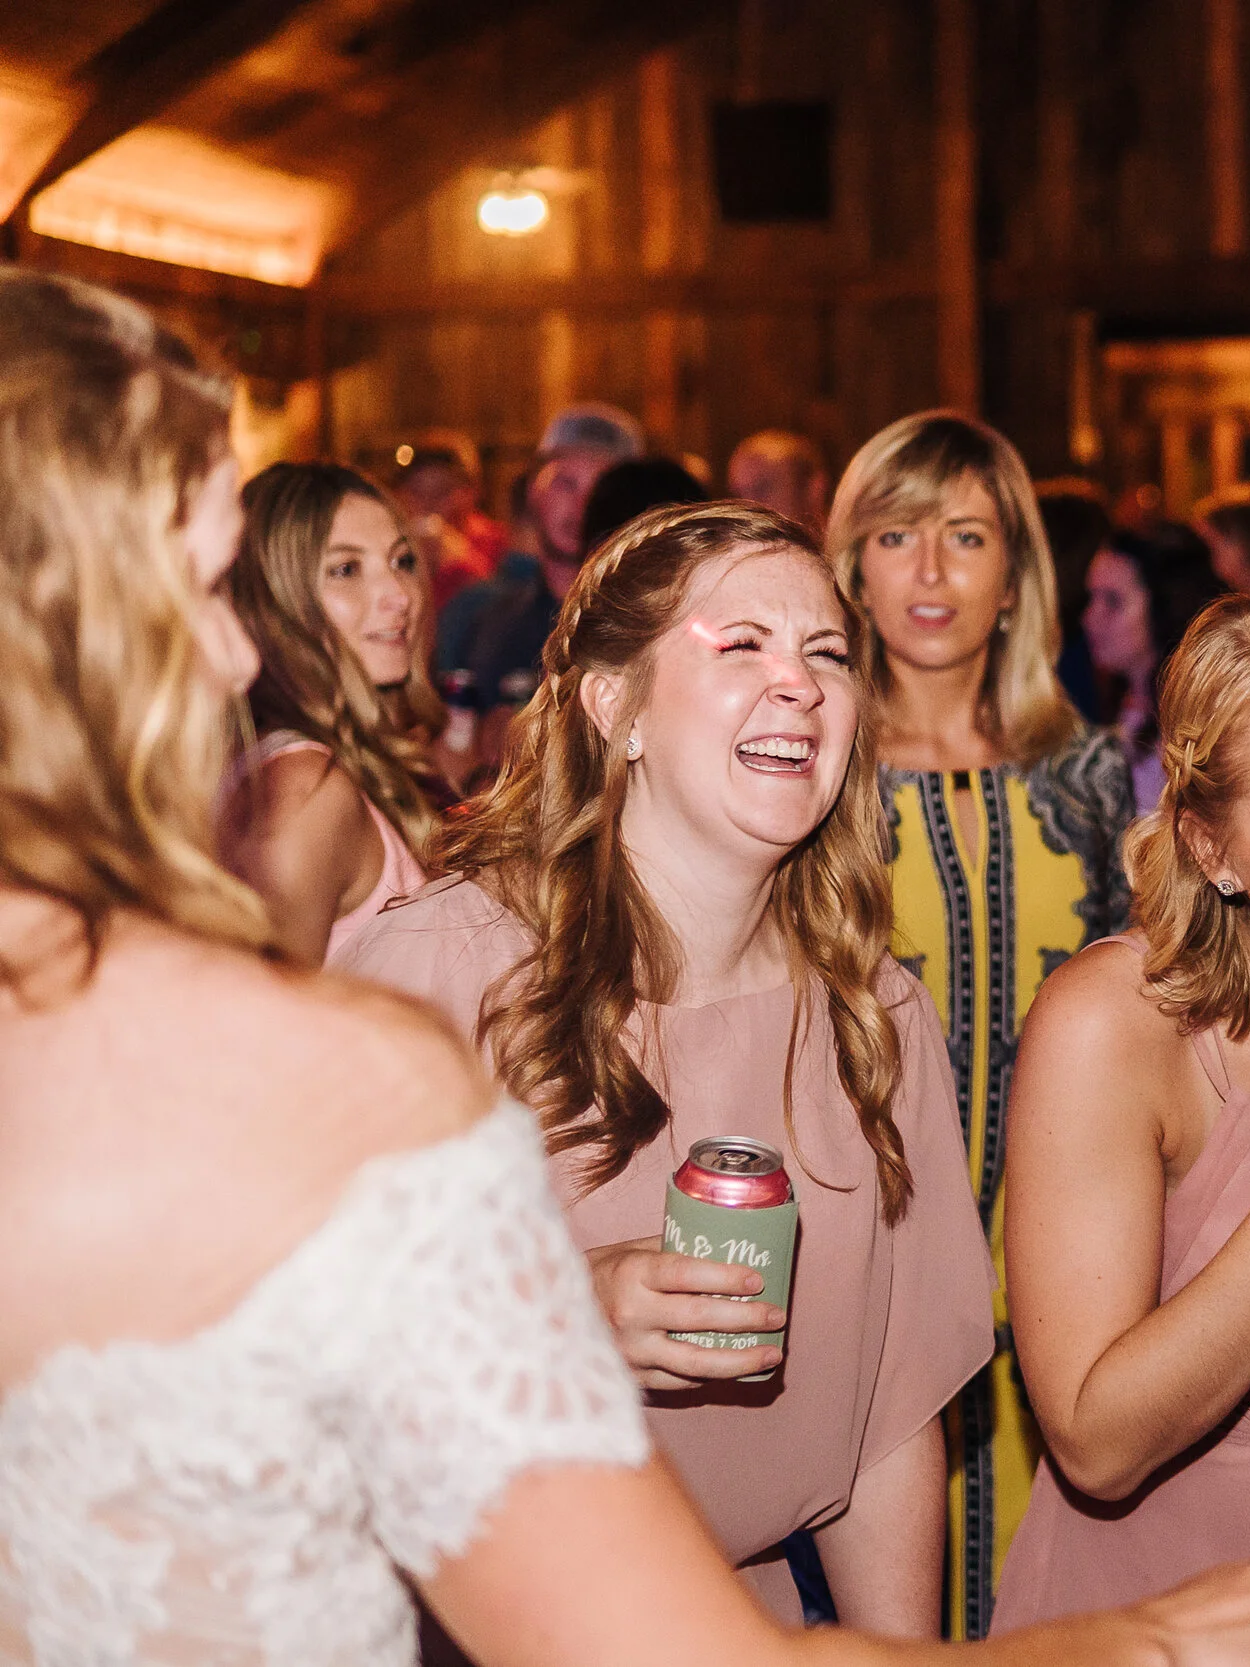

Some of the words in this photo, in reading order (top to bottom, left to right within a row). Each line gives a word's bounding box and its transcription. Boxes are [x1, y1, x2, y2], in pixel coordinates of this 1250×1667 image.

[664, 1214, 688, 1256] Mr.
[692, 1234, 713, 1259] &
[719, 1239, 772, 1268] Mrs.
[719, 1338, 727, 1349] 7
[731, 1335, 758, 1350] 2019
